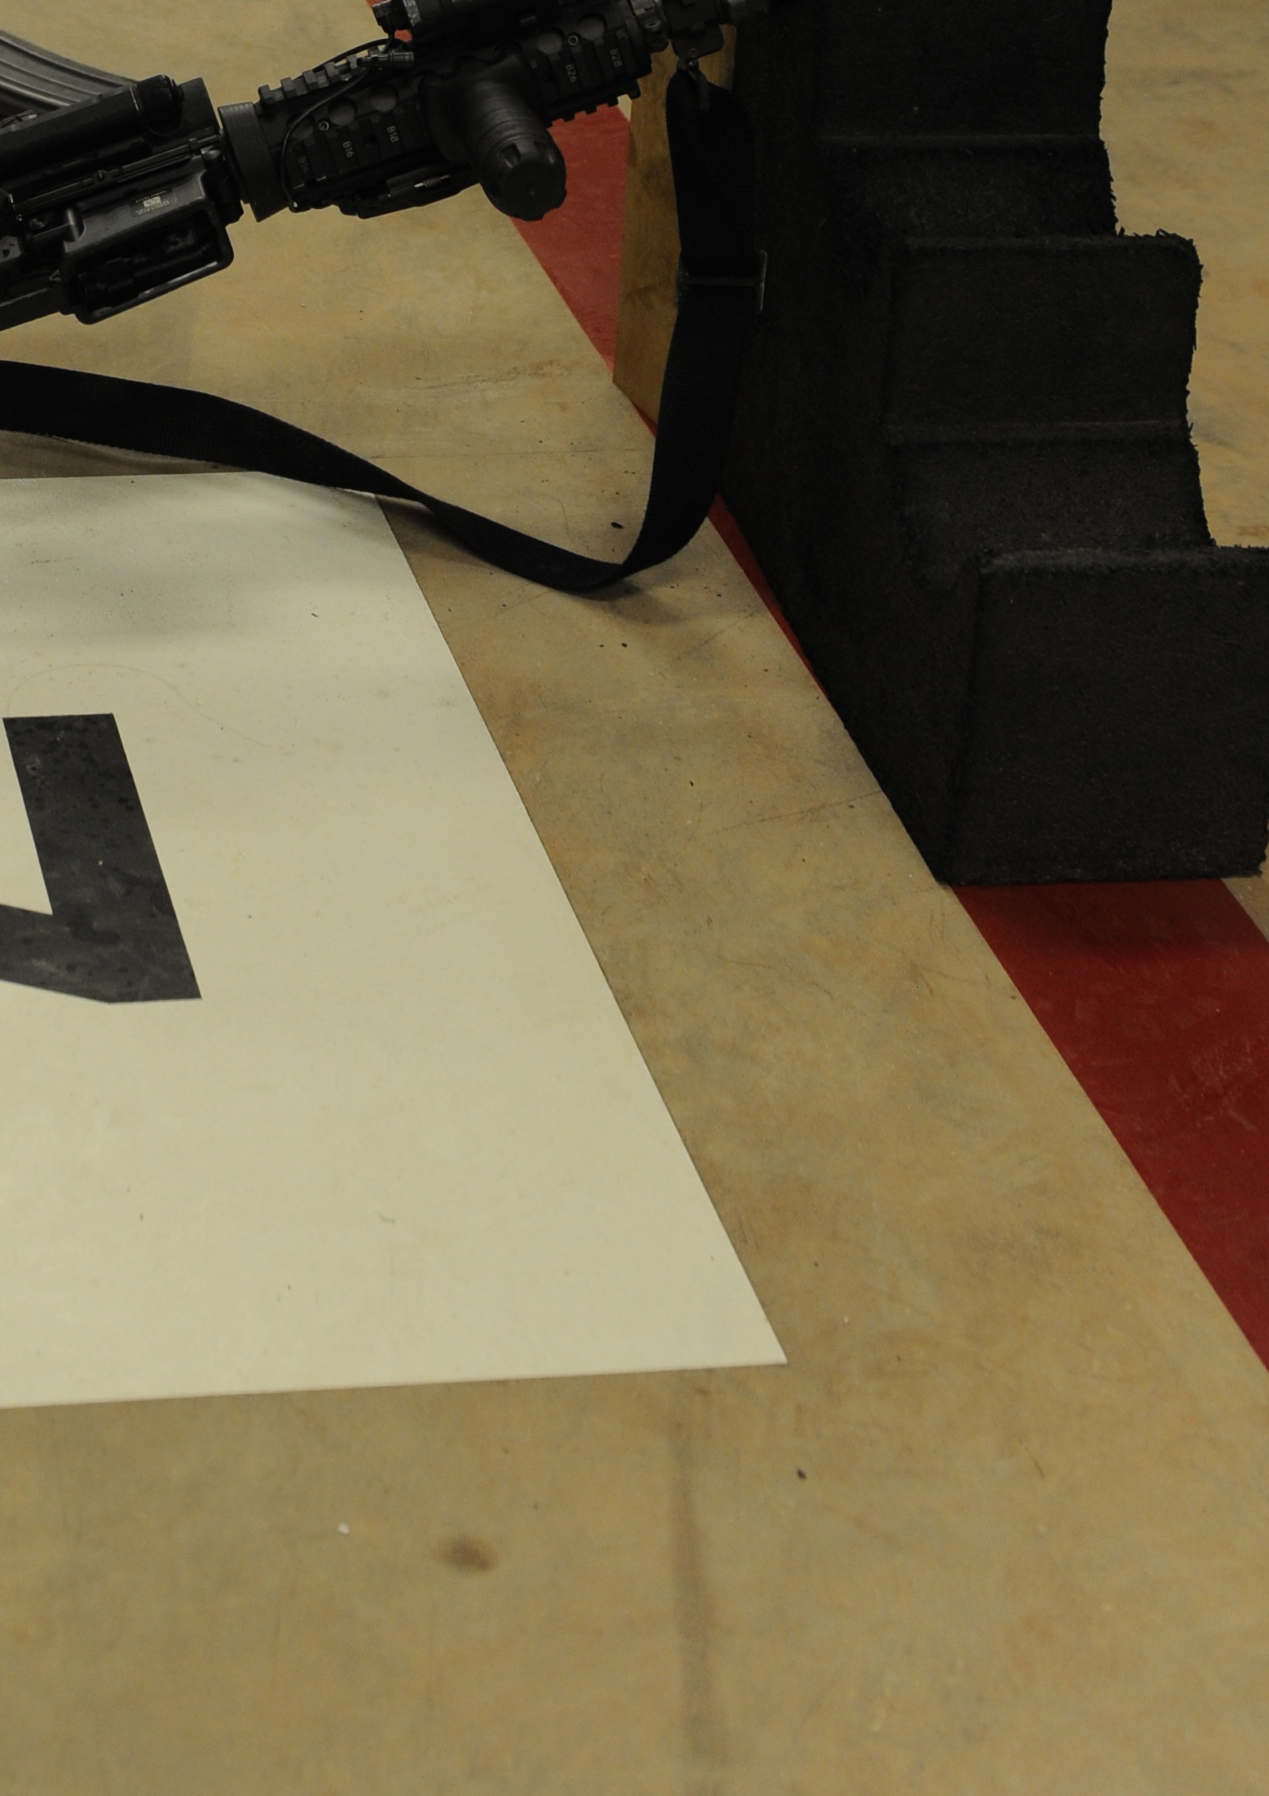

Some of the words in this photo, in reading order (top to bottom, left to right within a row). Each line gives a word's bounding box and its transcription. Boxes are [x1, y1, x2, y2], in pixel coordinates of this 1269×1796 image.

[609, 48, 623, 68] B28
[565, 63, 579, 83] B26
[386, 125, 400, 143] B18
[342, 140, 355, 158] B16
